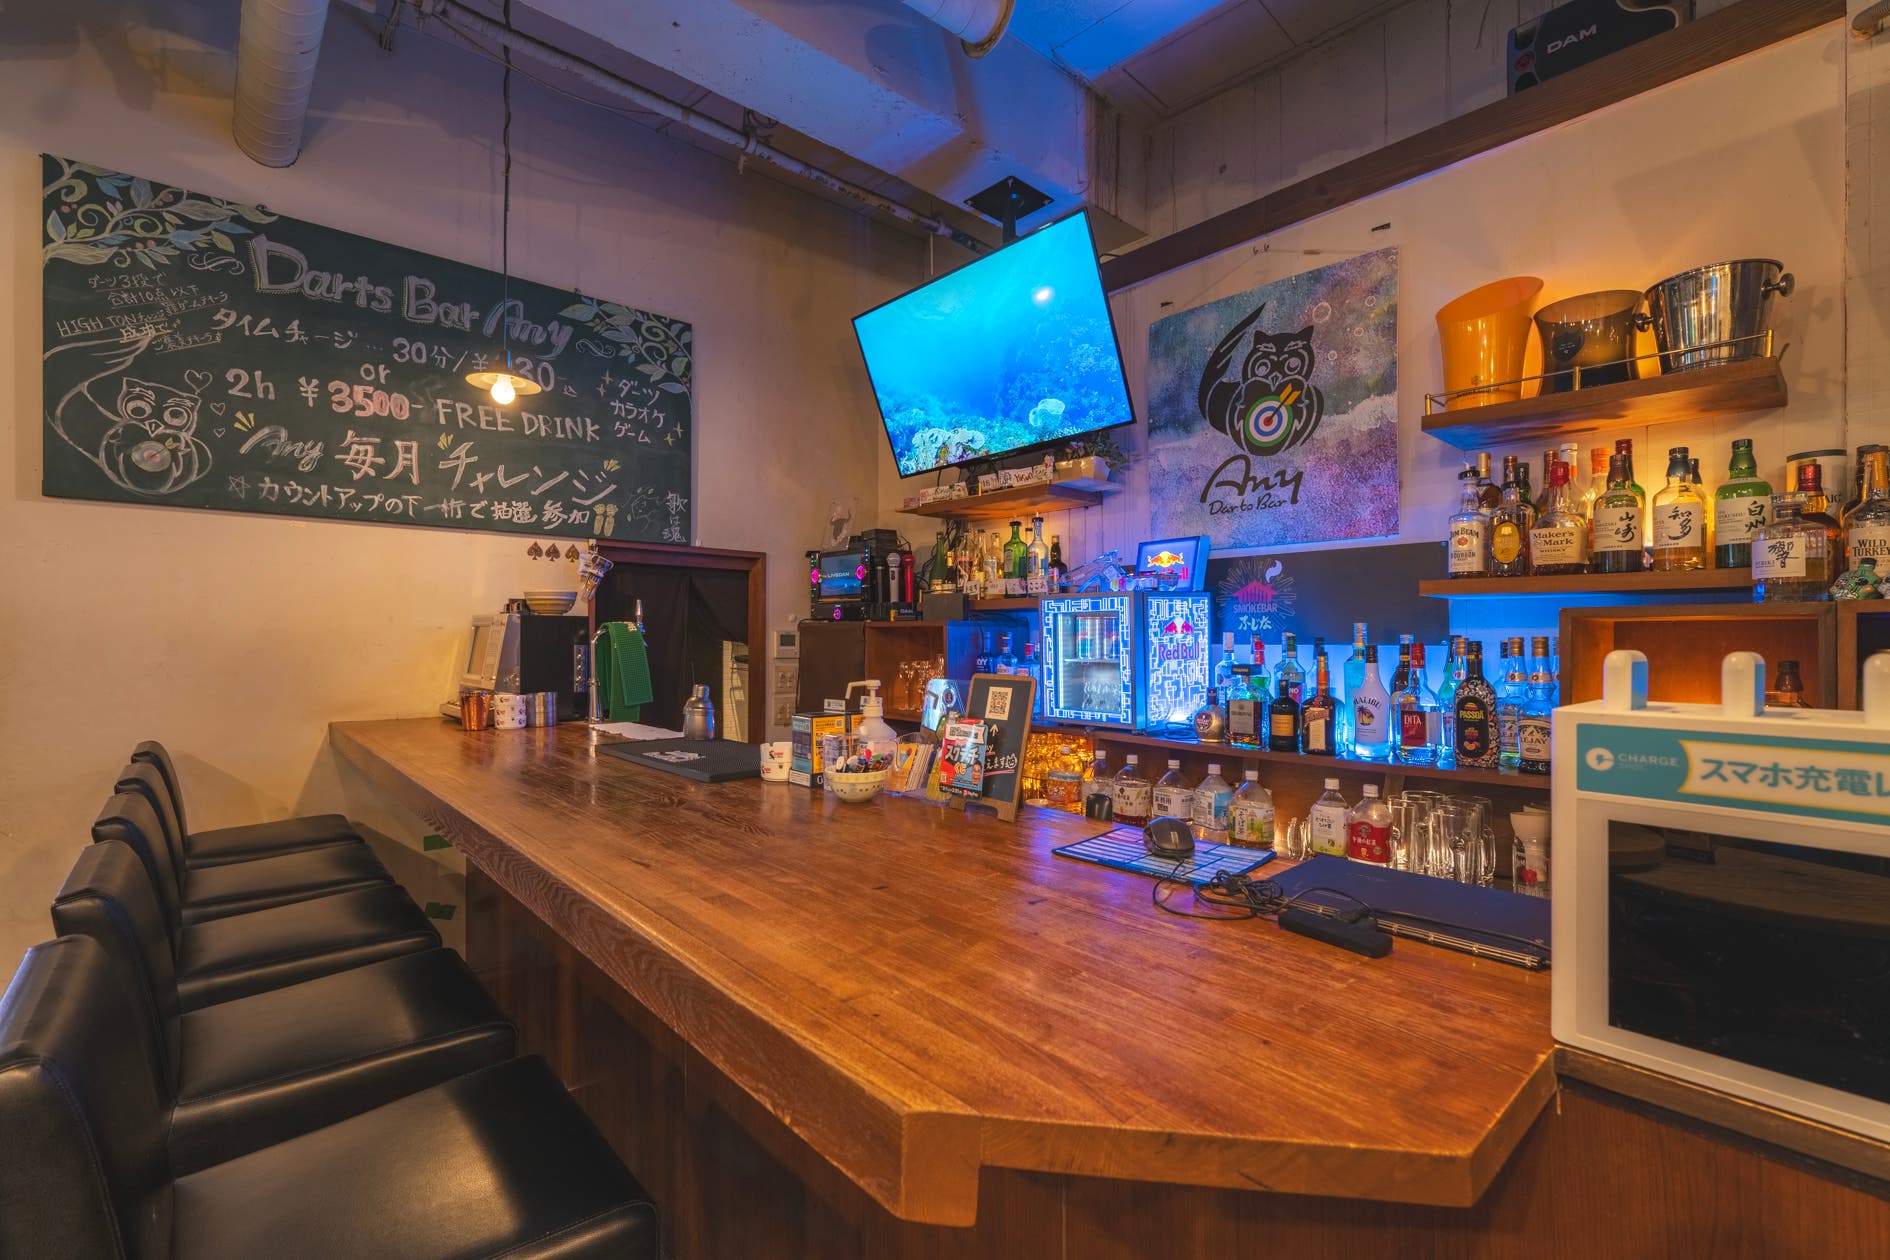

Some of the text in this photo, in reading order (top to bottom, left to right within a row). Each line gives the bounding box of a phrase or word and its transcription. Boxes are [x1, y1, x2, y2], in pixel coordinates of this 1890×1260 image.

[1546, 24, 1598, 54] DAM
[248, 233, 574, 360] Darts Bar Any
[57, 315, 104, 338] HIGH
[360, 363, 391, 385] or
[618, 379, 661, 406] ダーツ
[225, 368, 276, 400] 2h
[435, 399, 515, 432] FREE
[520, 411, 601, 442] DRINK
[610, 400, 667, 428] カラオケ
[613, 421, 652, 444] ゲーム
[335, 429, 420, 486] 毎月
[438, 441, 618, 506] チャレンジ
[1200, 454, 1304, 505] Any
[1209, 493, 1288, 516] Darts Bar
[1614, 511, 1637, 543] 山崎
[1668, 506, 1692, 541] 知多
[1744, 500, 1767, 534] 白州
[1460, 526, 1479, 538] BEAM
[1533, 530, 1575, 540] Maker's
[1543, 538, 1574, 546] Mark
[1857, 539, 1887, 548] WILD
[1233, 602, 1278, 614] SMOKEBAR
[1158, 640, 1200, 660] Red Bull
[1353, 696, 1384, 709] MALIBU
[1403, 714, 1422, 725] DITA
[1617, 752, 1679, 767] CHARGE
